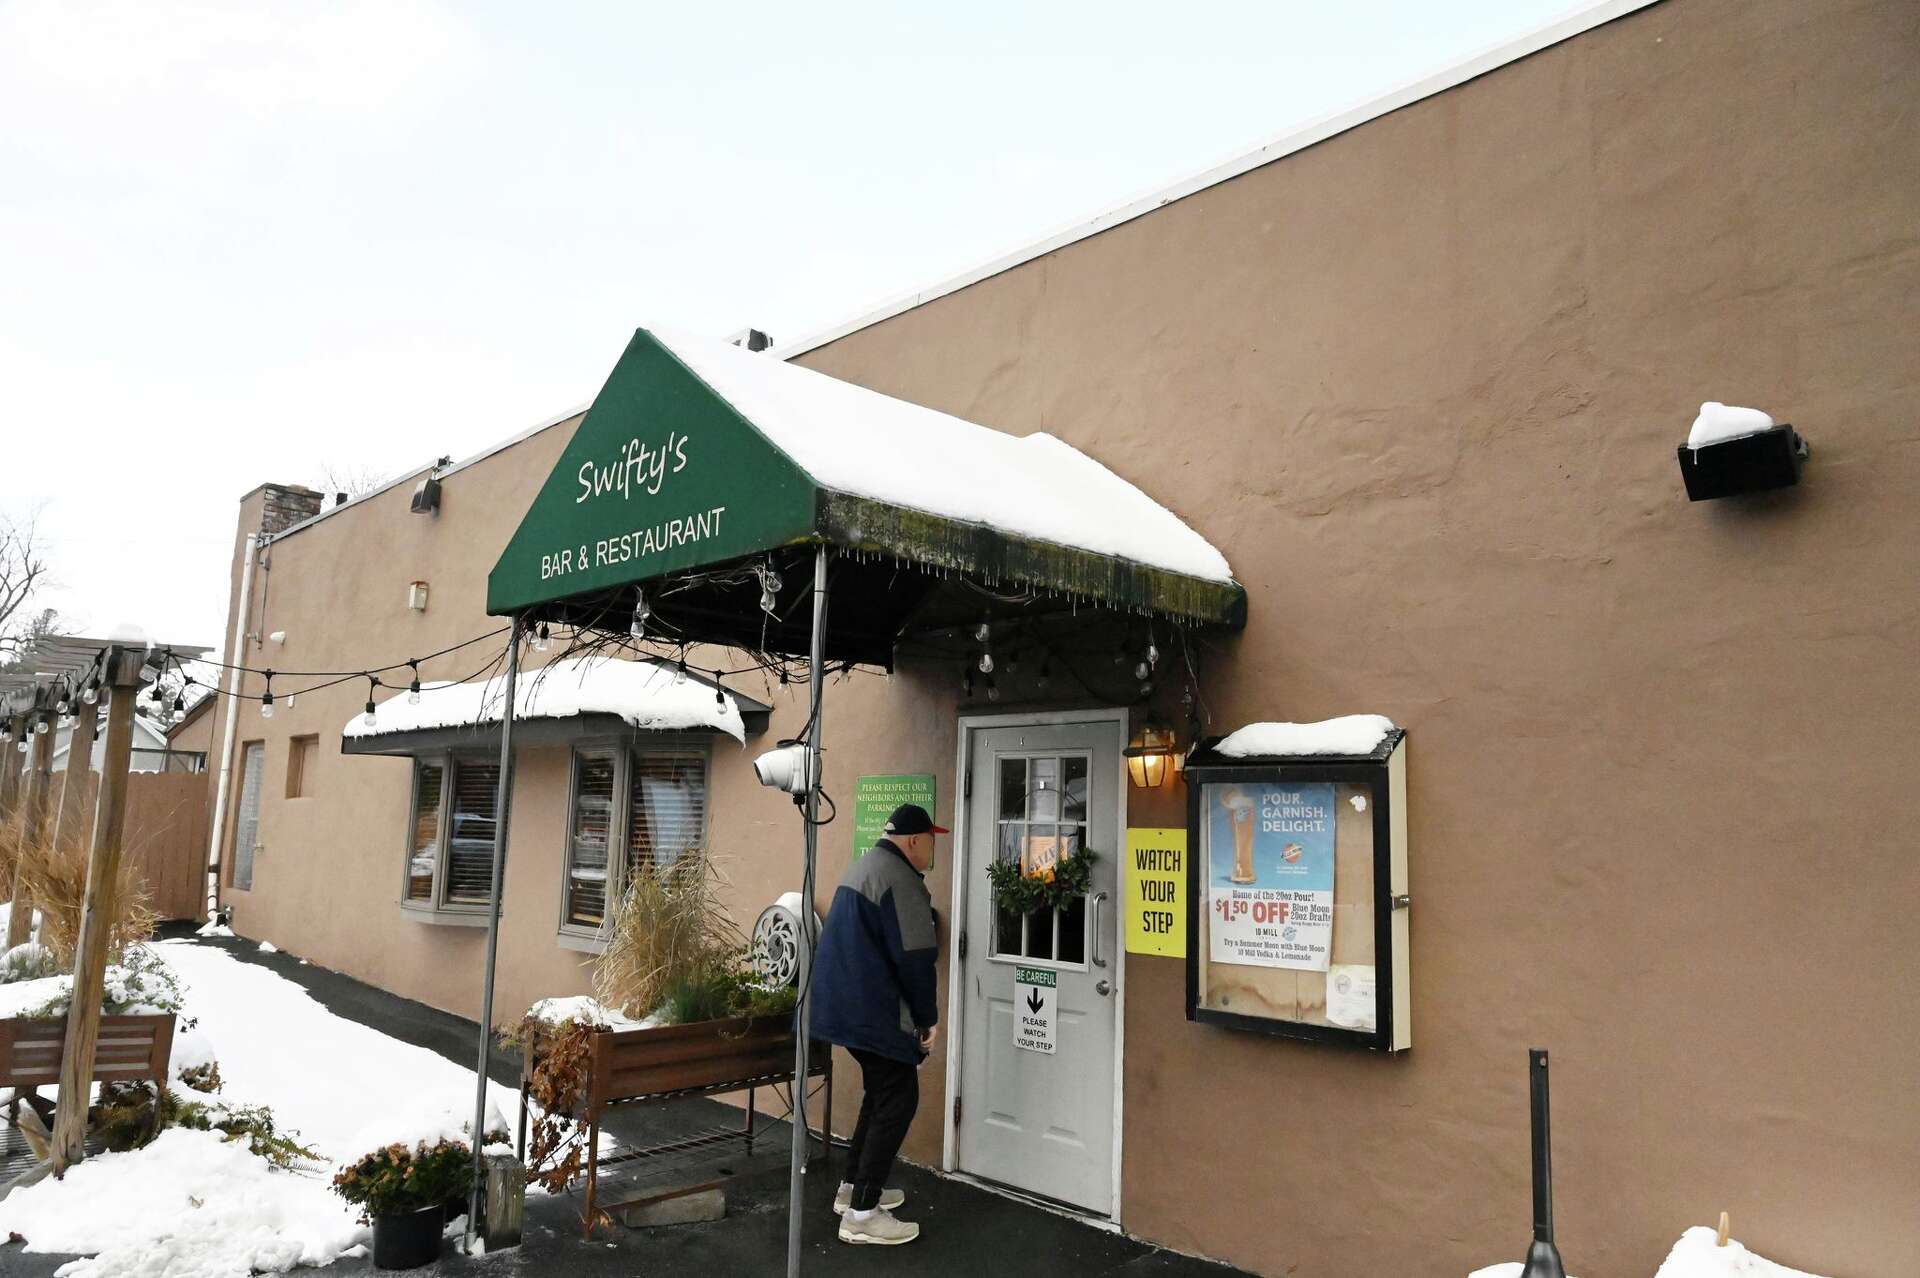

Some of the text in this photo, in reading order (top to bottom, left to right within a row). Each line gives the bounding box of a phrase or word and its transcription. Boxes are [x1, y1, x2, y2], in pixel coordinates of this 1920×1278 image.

[576, 431, 688, 504] Swifty's
[541, 507, 725, 580] BAR & RESTAURANT
[862, 783, 927, 792] PLEASE RESPECT OUR
[857, 793, 933, 802] NEIGHBORS AND THEIR
[1262, 792, 1304, 805] POUR.
[1262, 806, 1328, 819] GARNISH.
[1262, 820, 1326, 833] DELIGHT.
[1136, 849, 1181, 872] WATCH
[1141, 880, 1175, 903] YOUR
[1233, 889, 1251, 899] Home
[1253, 891, 1261, 899] of
[1263, 892, 1274, 900] the
[1294, 892, 1315, 902] Pour!
[1215, 899, 1289, 924] $1.50 OFF
[1292, 903, 1330, 914] Blue Moon
[1143, 911, 1173, 934] STEP
[1290, 912, 1307, 922] 20oz
[1263, 928, 1278, 937] MILL
[1224, 938, 1233, 947] Try
[1239, 940, 1263, 948] Summer
[1264, 942, 1280, 950] Moon
[1281, 943, 1293, 951] with
[1294, 944, 1308, 952] Blue
[1309, 945, 1326, 953] Moon
[1256, 950, 1273, 959] Vodka
[1281, 952, 1312, 961] Lemonade
[1016, 969, 1056, 986] BE CAREFUL
[1022, 1016, 1047, 1027] PLEASE
[1023, 1028, 1046, 1038] WATCH
[1017, 1037, 1053, 1051] YOUR STEP
